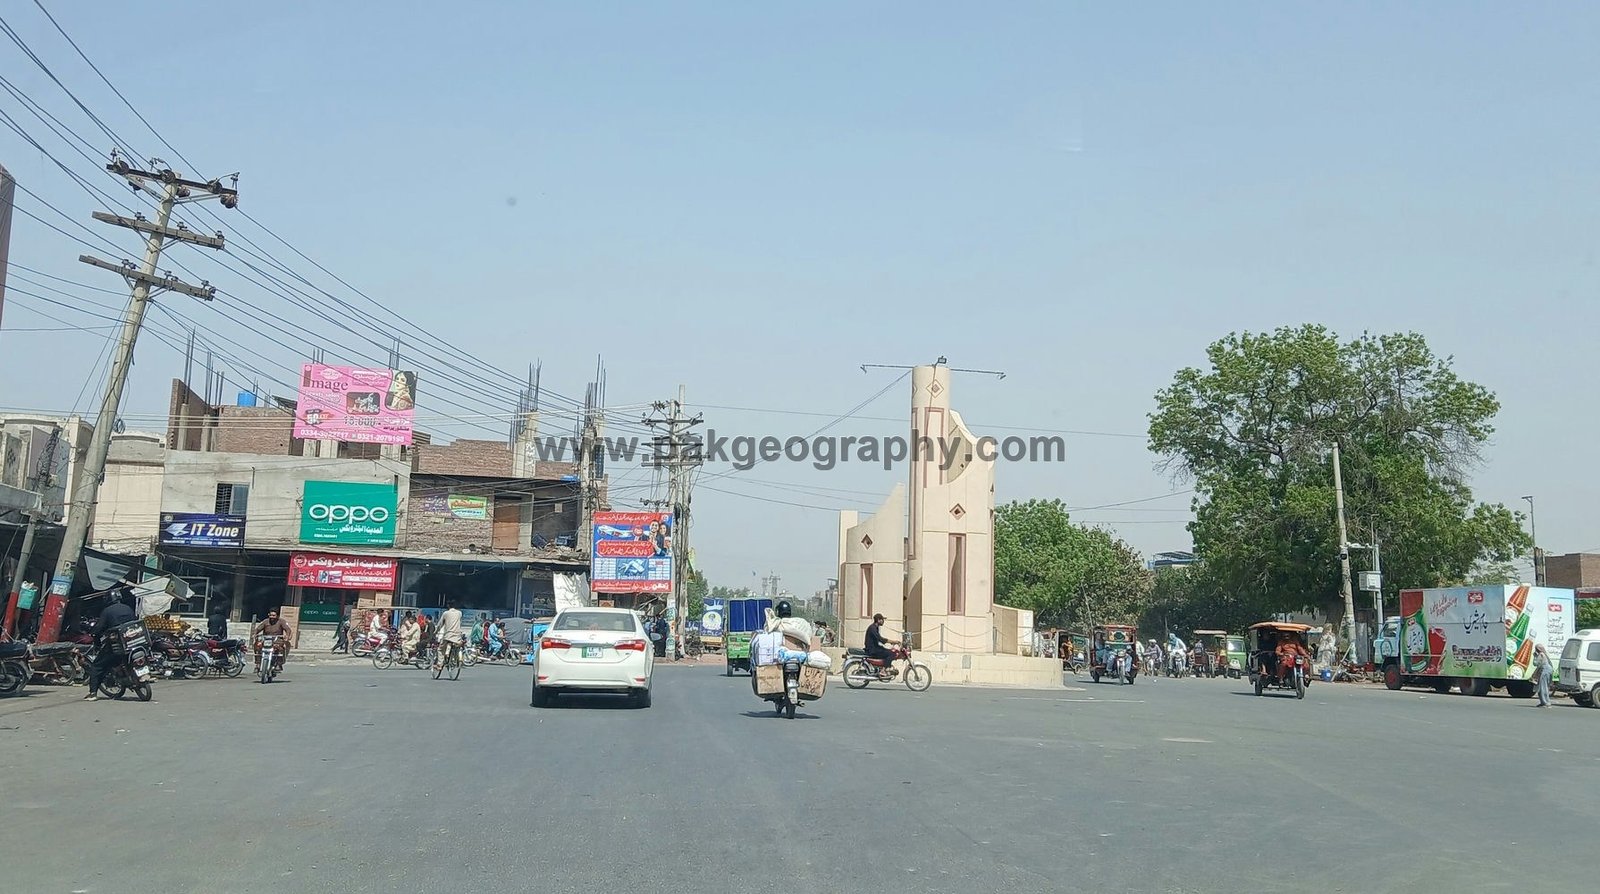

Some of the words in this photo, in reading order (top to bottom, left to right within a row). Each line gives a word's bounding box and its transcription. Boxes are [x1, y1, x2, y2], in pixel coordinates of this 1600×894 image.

[303, 365, 348, 393] Image
[309, 503, 389, 525] oppo
[190, 523, 206, 536] IT
[206, 523, 240, 537] Zone
